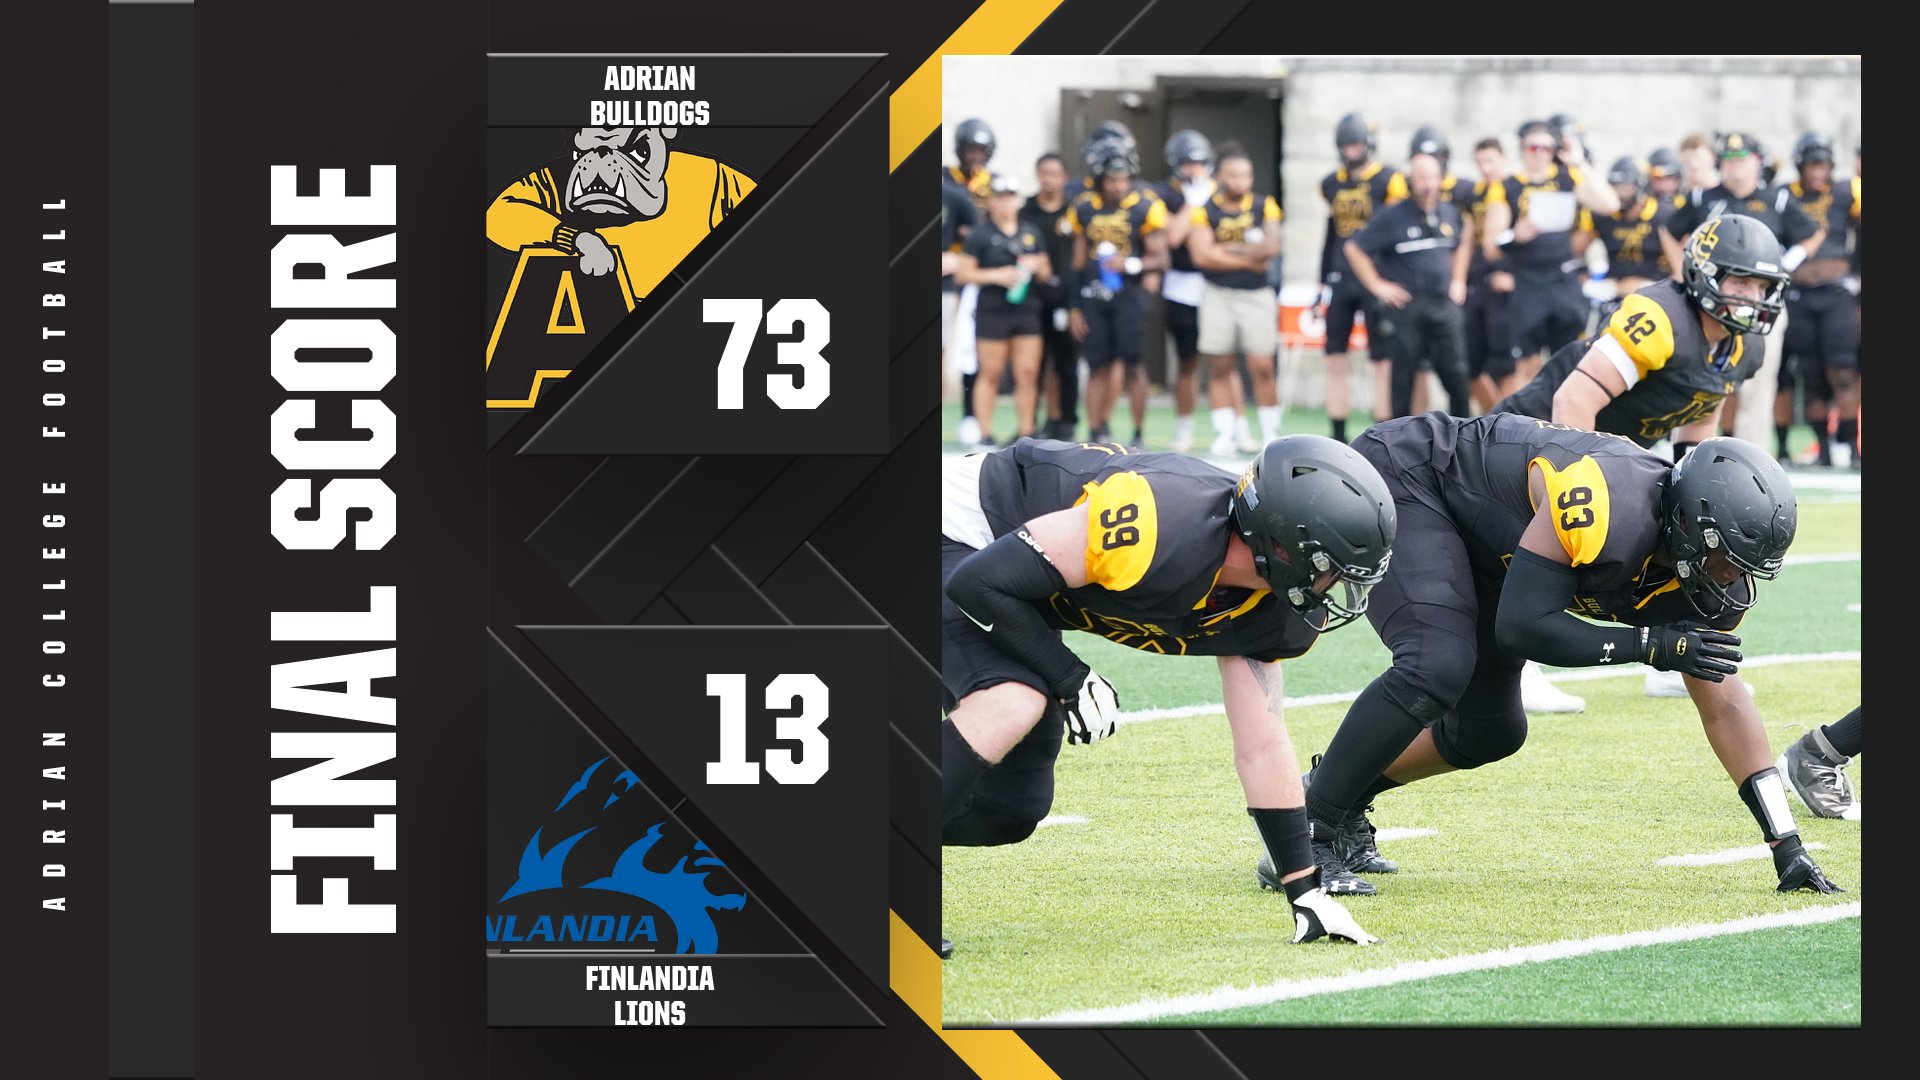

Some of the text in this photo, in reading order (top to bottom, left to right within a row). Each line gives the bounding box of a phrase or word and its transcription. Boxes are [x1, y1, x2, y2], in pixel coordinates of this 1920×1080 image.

[1623, 312, 1656, 346] 42
[1100, 503, 1140, 551] 99
[1558, 486, 1595, 531] 93
[1583, 597, 1606, 615] BUL
